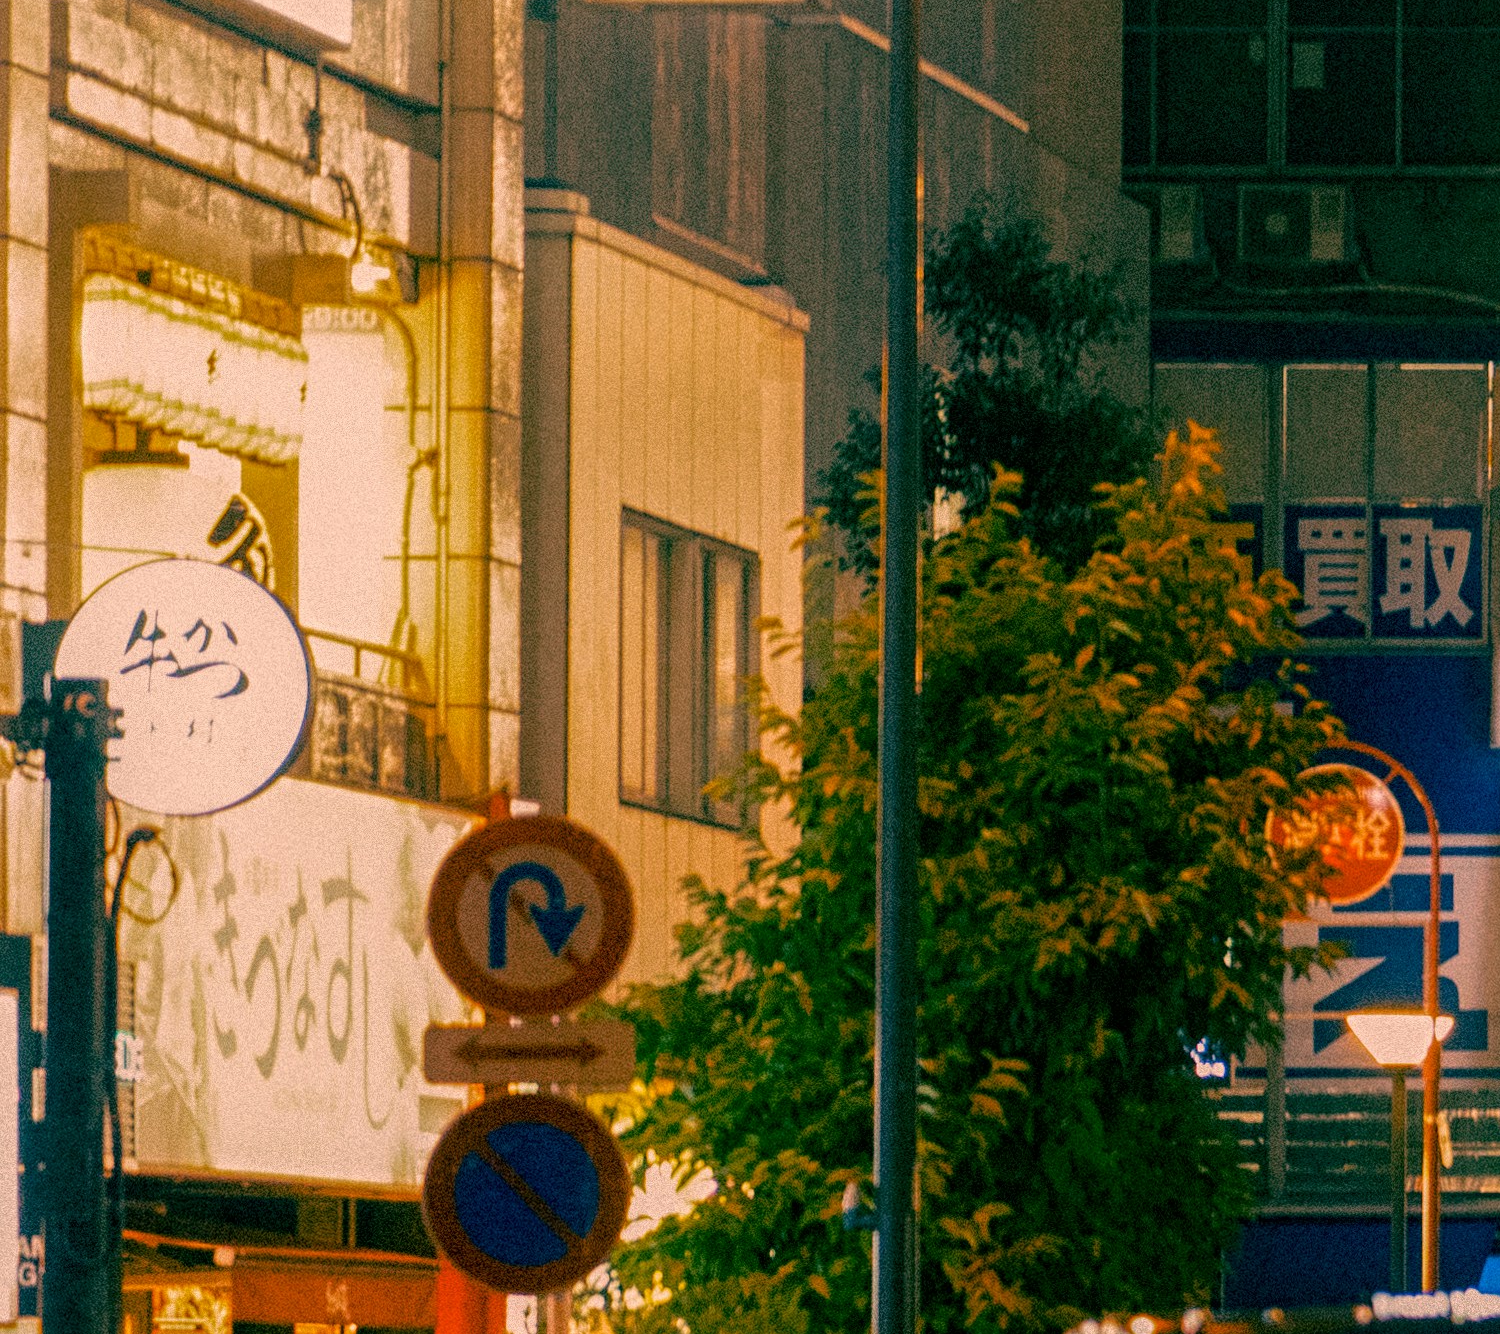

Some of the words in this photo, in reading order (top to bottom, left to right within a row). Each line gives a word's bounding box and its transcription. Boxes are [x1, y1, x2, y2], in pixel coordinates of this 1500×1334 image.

[1297, 518, 1475, 629] 買取
[129, 613, 292, 727] 牛かつ
